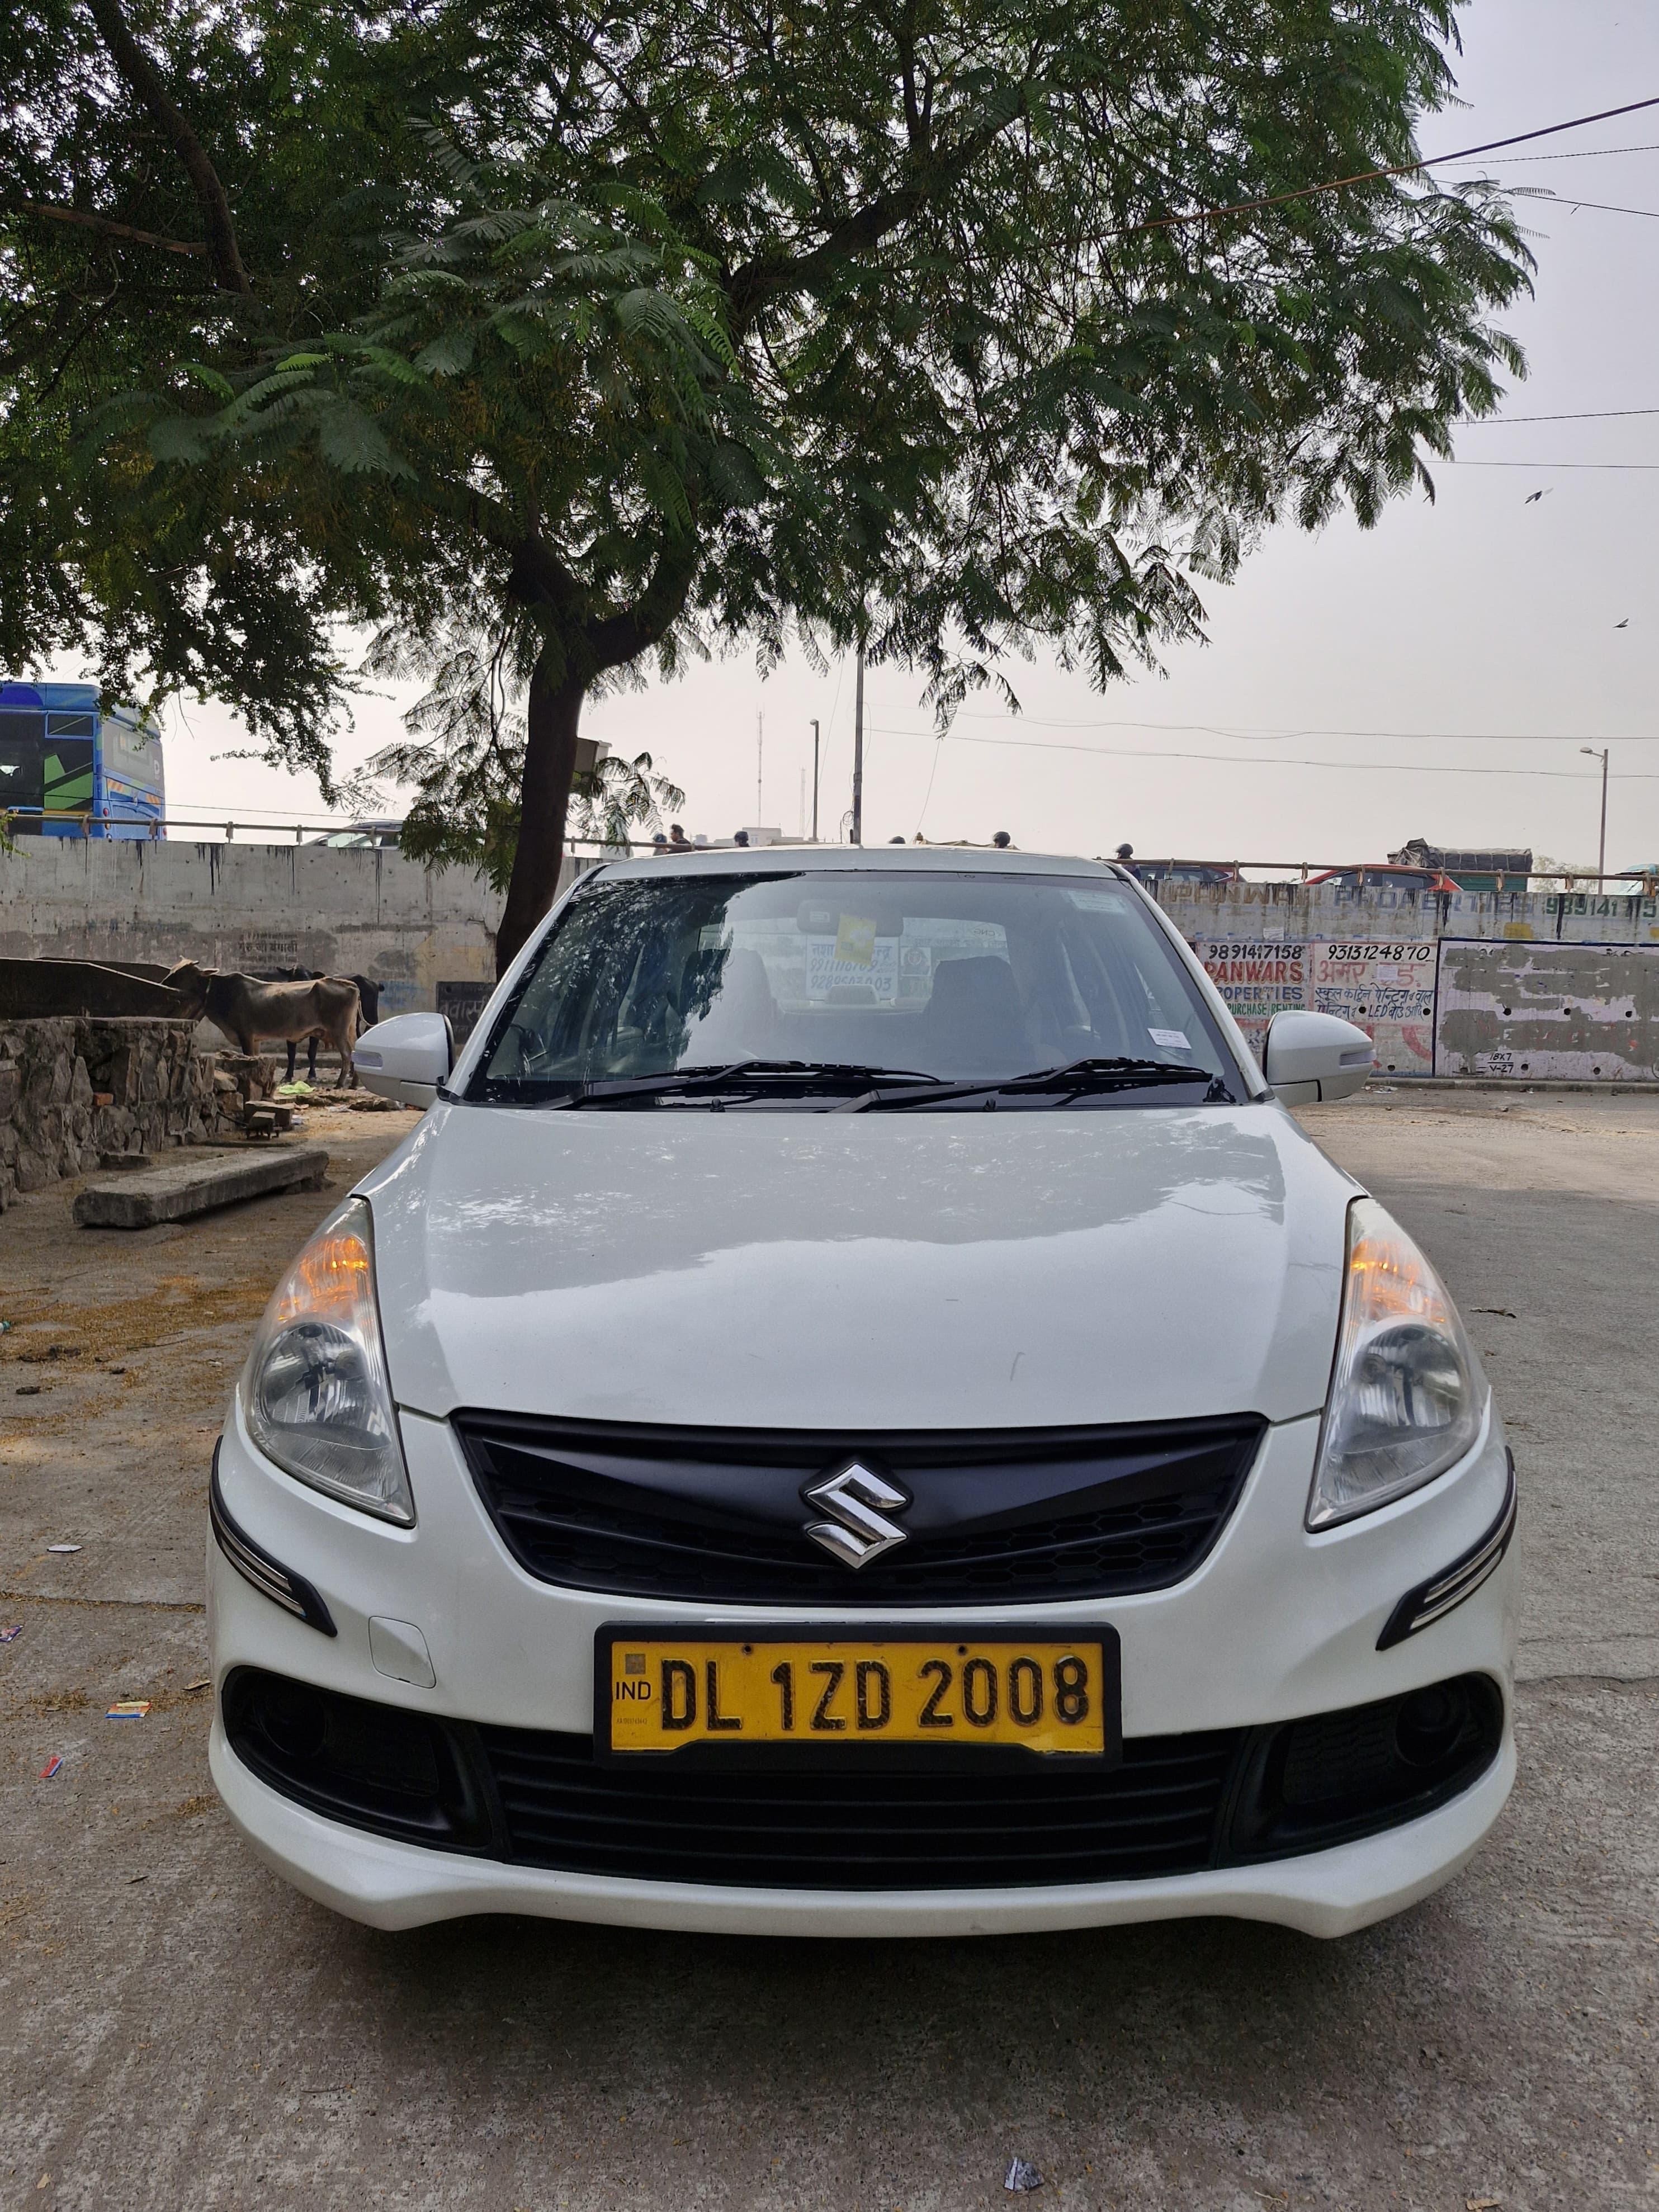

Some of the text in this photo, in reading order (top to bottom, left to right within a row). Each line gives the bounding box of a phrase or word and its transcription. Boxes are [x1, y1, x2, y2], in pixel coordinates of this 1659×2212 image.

[1329, 944, 1430, 960] 9313124870
[1204, 961, 1303, 984] PANWARS
[1368, 1004, 1387, 1017] LED
[1490, 1064, 1514, 1074] V-27
[616, 1681, 651, 1700] IND
[662, 1658, 742, 1730] DL
[917, 1656, 1090, 1727] 2008
